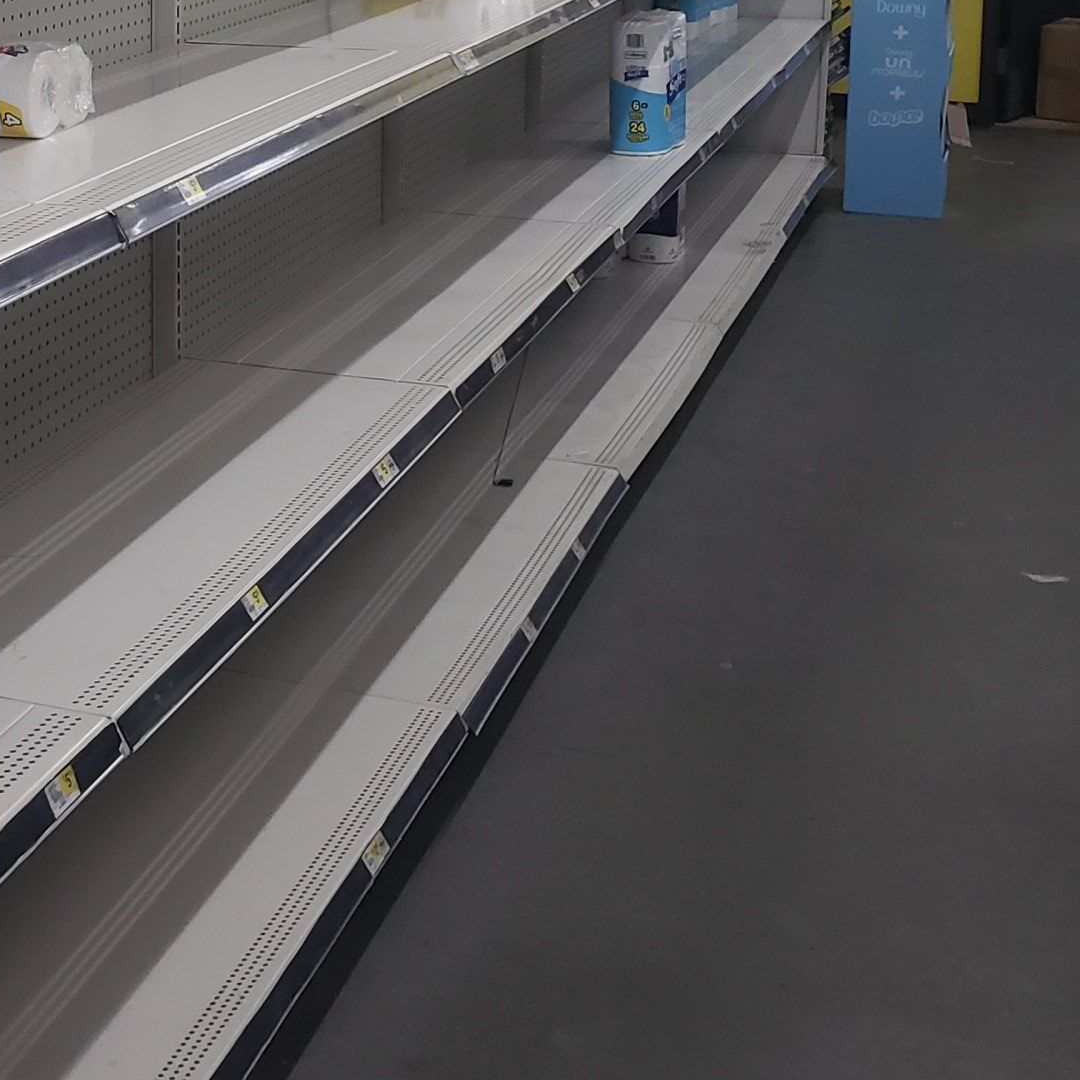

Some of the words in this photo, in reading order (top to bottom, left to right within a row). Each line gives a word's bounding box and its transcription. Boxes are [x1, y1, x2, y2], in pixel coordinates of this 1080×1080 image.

[877, 0, 926, 18] Downy
[632, 101, 639, 110] 6
[3, 112, 22, 127] 4
[630, 121, 646, 133] 24
